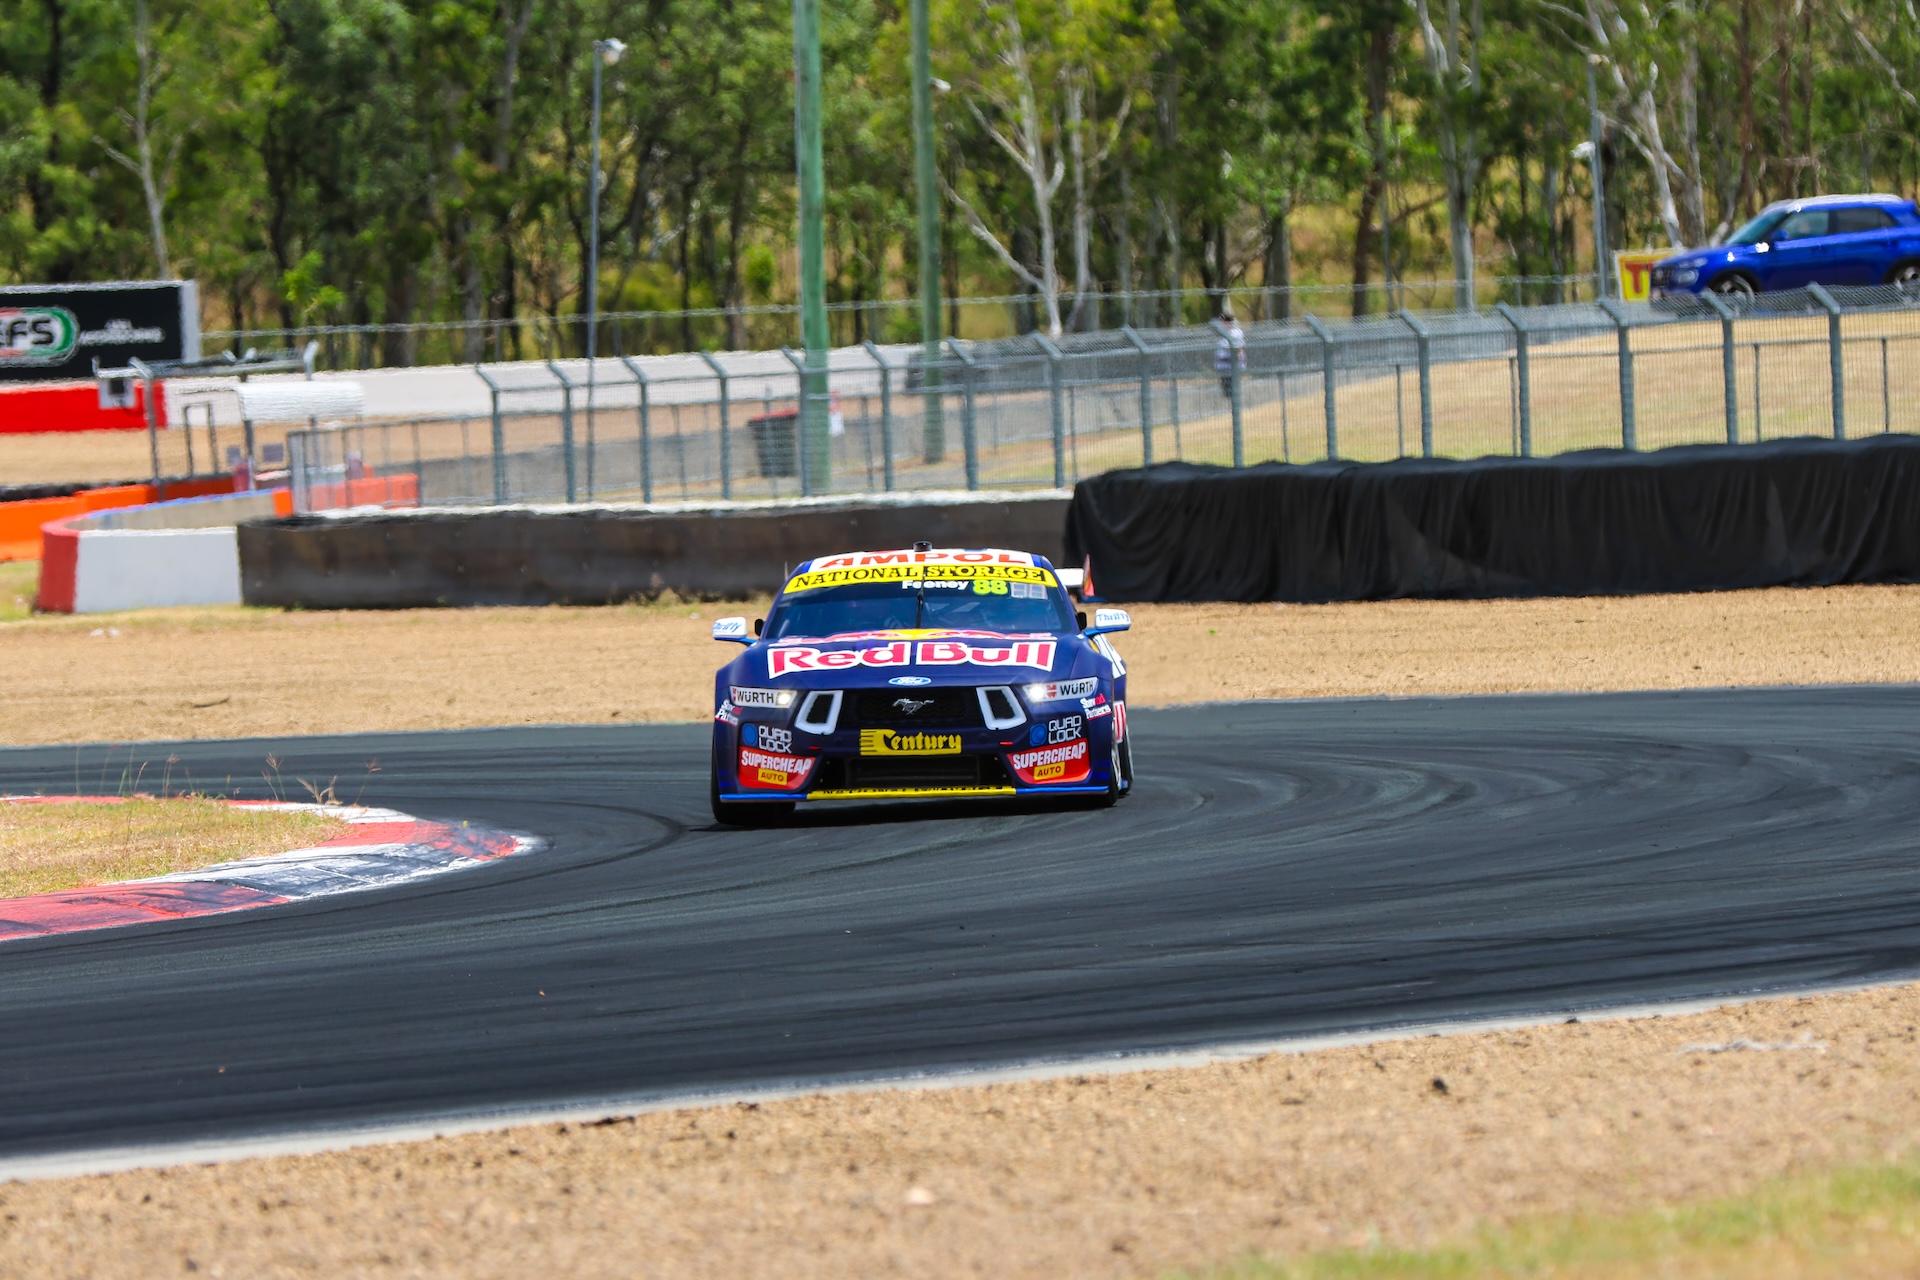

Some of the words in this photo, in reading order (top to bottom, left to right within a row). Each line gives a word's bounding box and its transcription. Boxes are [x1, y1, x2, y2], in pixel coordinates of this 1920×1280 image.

[0, 318, 54, 347] FS
[820, 553, 1026, 569] AMPOL
[795, 567, 918, 588] NATIONAL
[925, 565, 1045, 582] STORAGE
[902, 580, 969, 590] Feeney
[972, 580, 1009, 596] 88
[1096, 612, 1130, 622] Thrifty
[771, 643, 908, 674] Red
[919, 642, 1052, 669] Bull
[737, 691, 775, 704] WÜRTH
[1060, 681, 1094, 697] WÜRTH
[1048, 715, 1082, 732] QUAD
[758, 725, 792, 742] QUAD
[868, 730, 962, 754] Century
[1048, 726, 1082, 744] LOCK
[758, 736, 792, 754] LOCK
[741, 751, 812, 775] SUPERCHEAP
[1012, 741, 1087, 770] SUPERCHEAP
[760, 771, 785, 782] AUTO
[1037, 765, 1062, 776] AUTO
